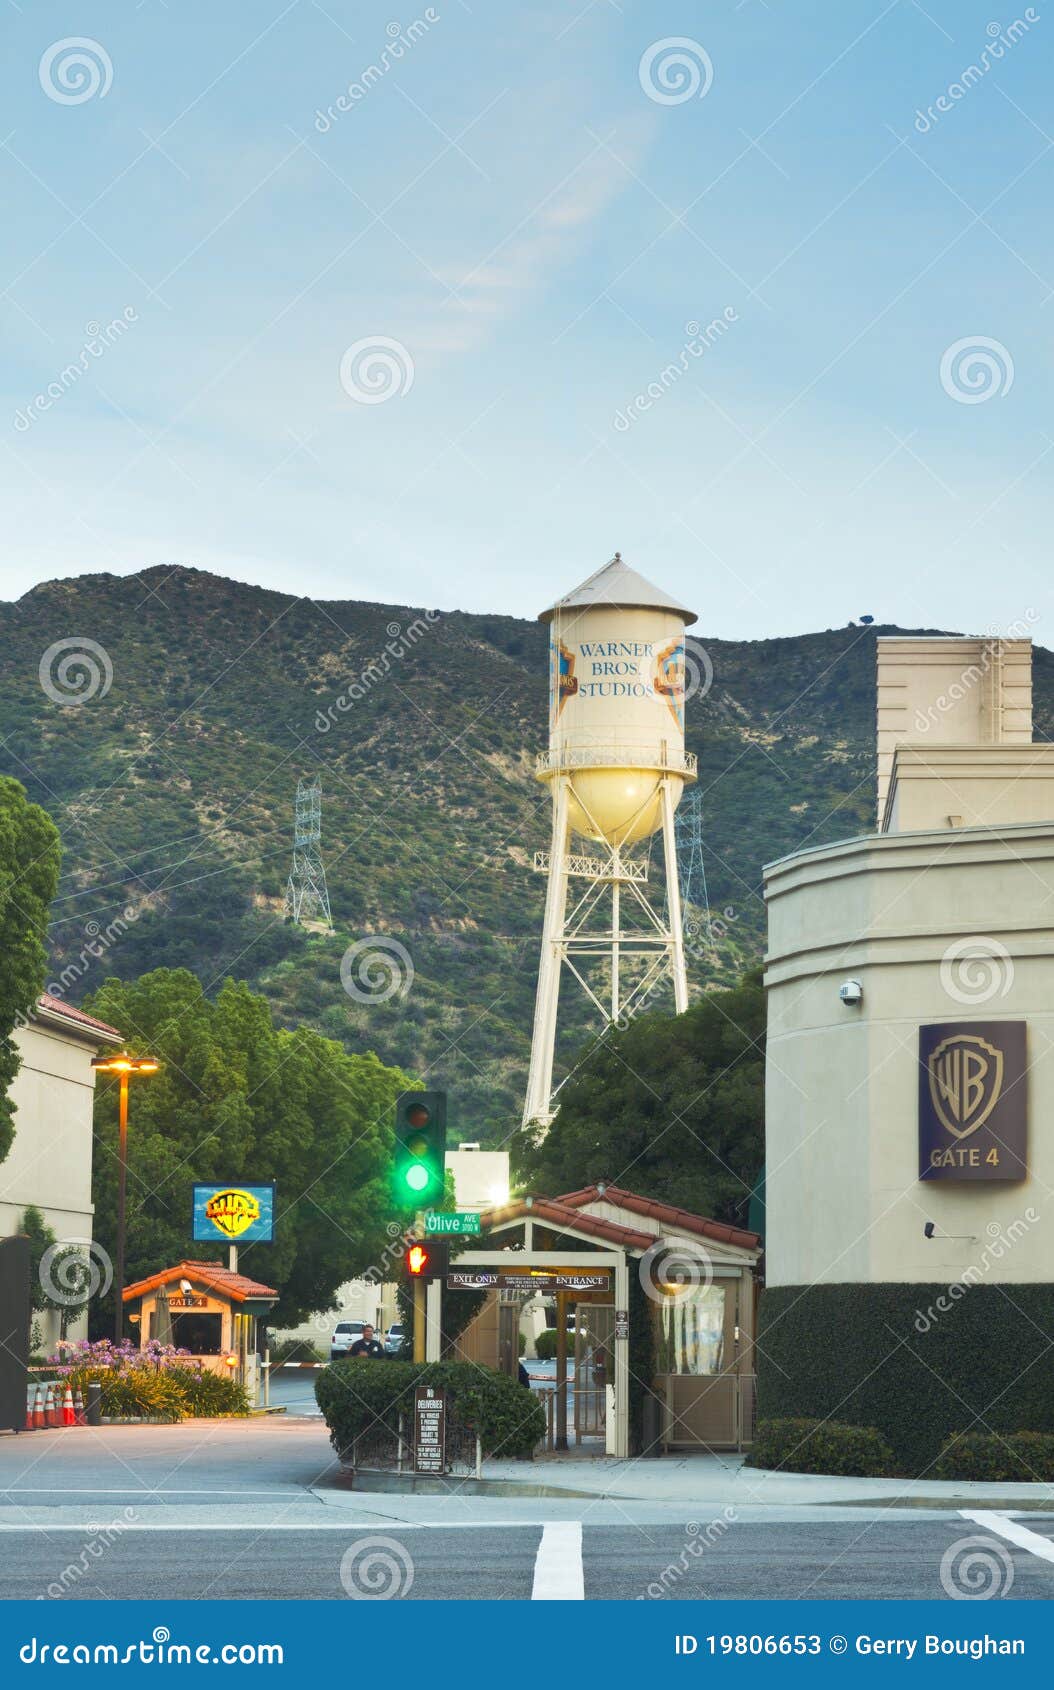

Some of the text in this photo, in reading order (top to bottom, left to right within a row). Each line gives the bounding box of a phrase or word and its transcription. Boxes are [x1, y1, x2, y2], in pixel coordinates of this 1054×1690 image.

[580, 642, 653, 658] WARNER
[579, 682, 653, 697] STUDIOS
[936, 1048, 989, 1122] WB
[930, 1148, 1000, 1167] GATE 4
[427, 1215, 460, 1231] Olive
[464, 1214, 477, 1223] AVE
[453, 1275, 473, 1283] EXIT
[475, 1275, 498, 1283] ONLY
[556, 1276, 604, 1285] ENTRANCE
